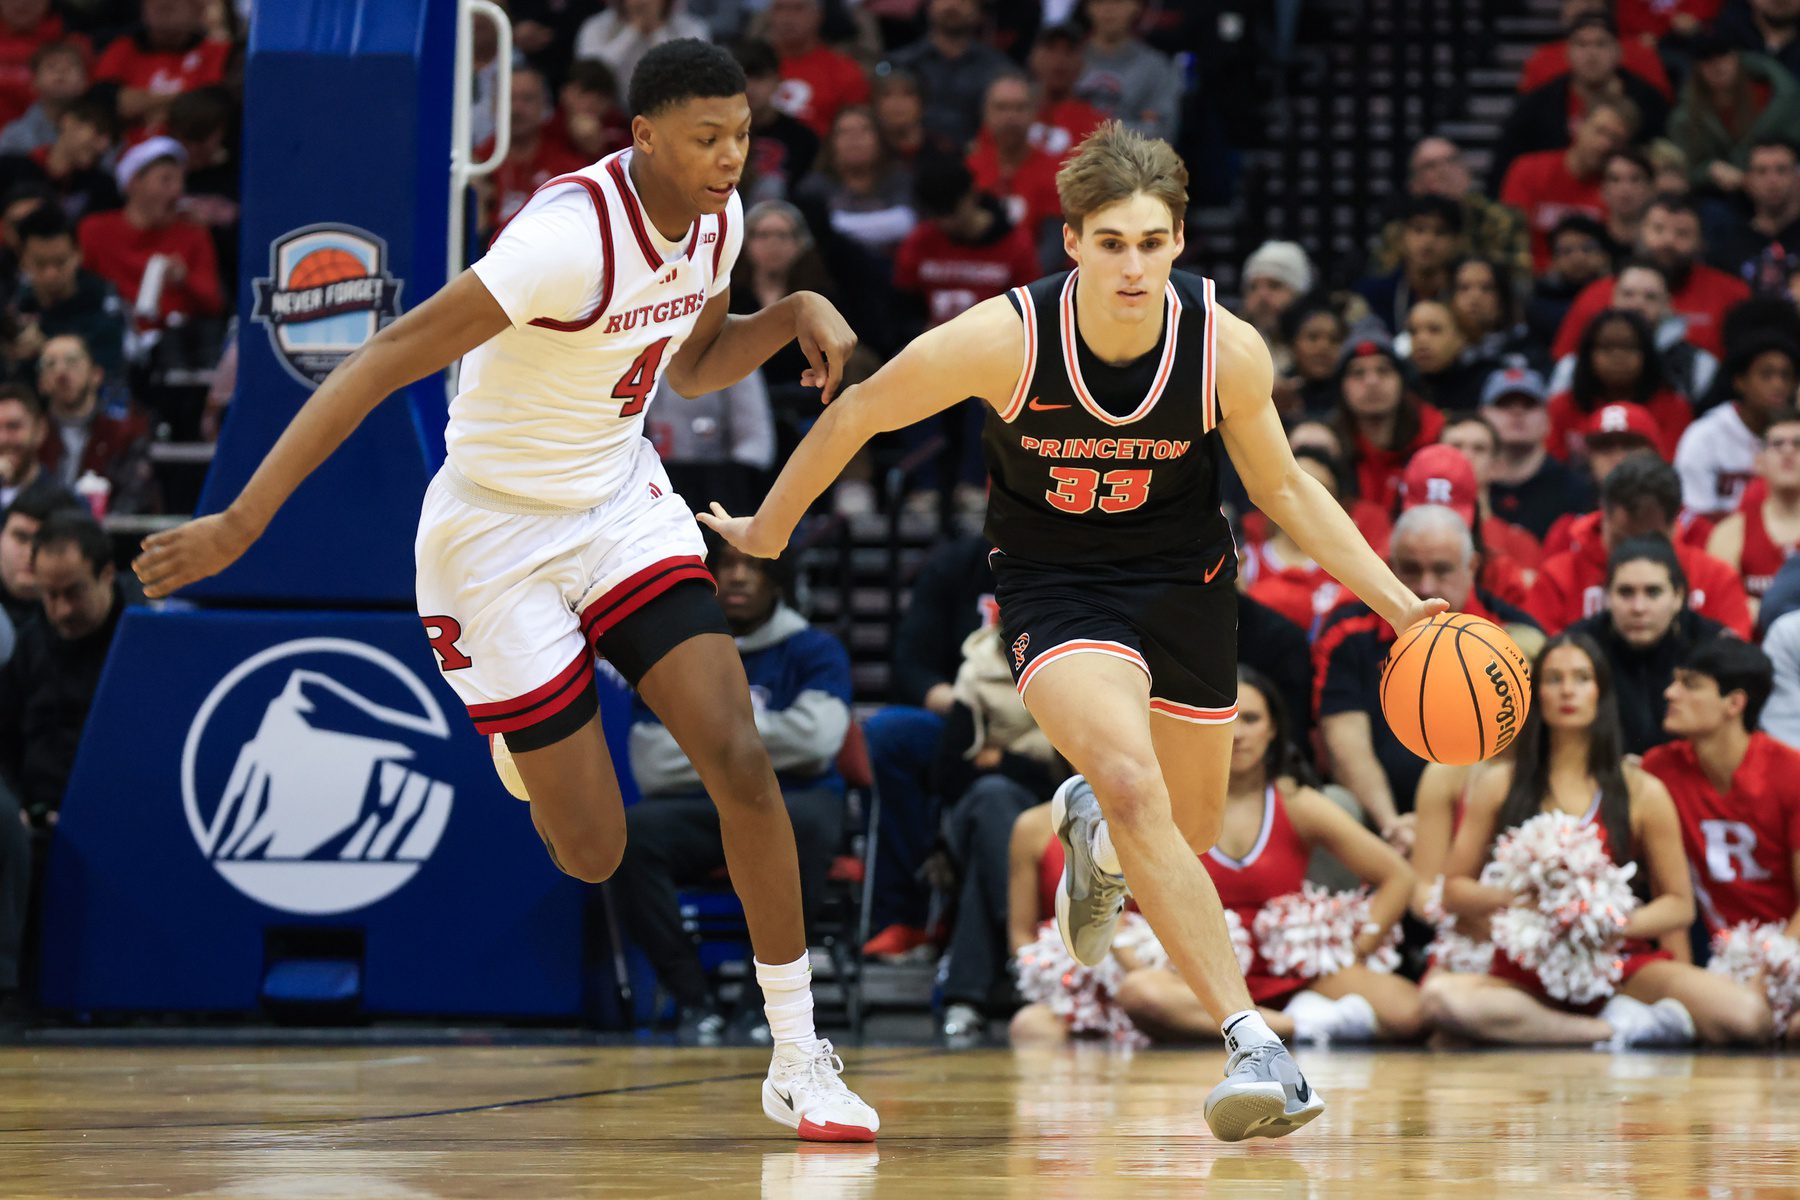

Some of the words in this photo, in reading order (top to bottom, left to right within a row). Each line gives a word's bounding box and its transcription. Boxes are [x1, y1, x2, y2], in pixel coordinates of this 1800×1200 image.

[272, 287, 323, 315] NEVER
[325, 278, 384, 307] FORGET
[603, 287, 705, 334] RUTGERS
[611, 336, 673, 418] 4
[1021, 435, 1191, 460] PRINCETON
[1045, 466, 1153, 514] 33
[420, 614, 473, 672] R
[1484, 659, 1517, 753] Wilson
[1699, 818, 1773, 882] R
